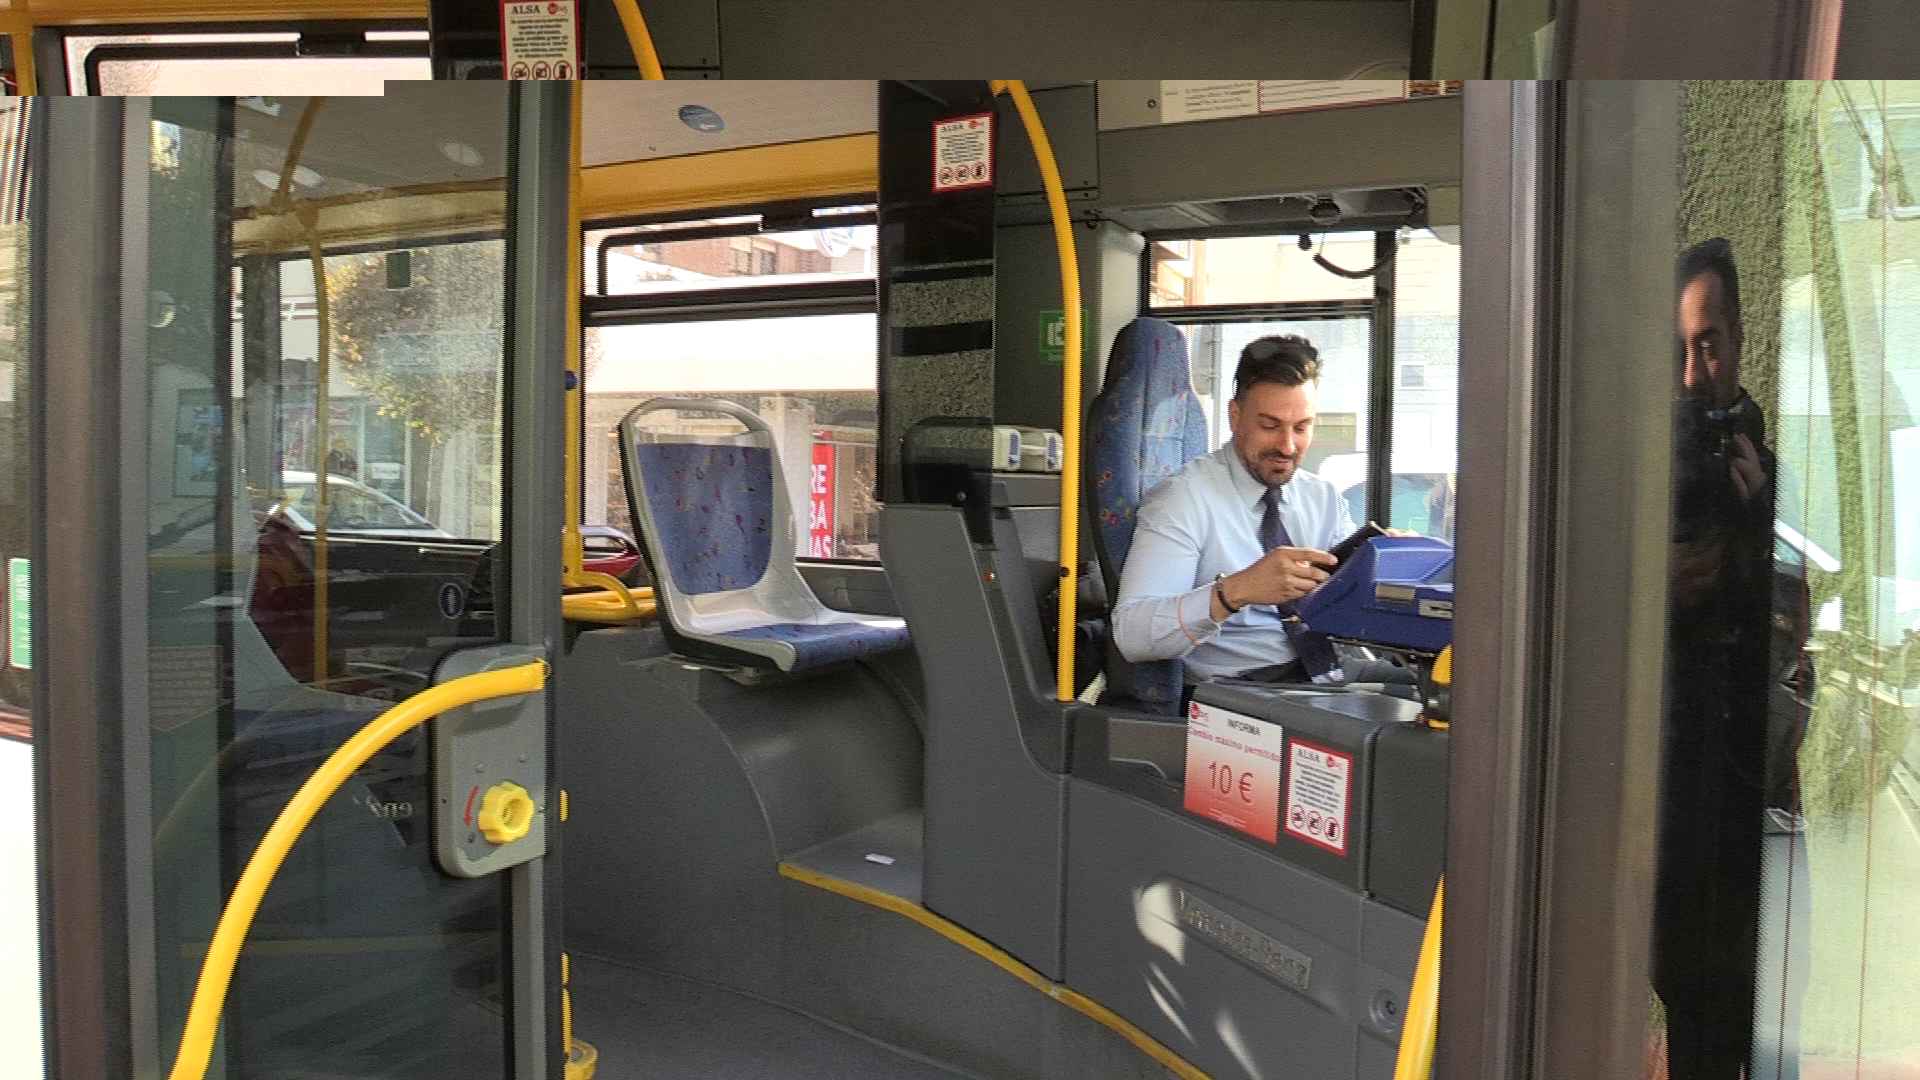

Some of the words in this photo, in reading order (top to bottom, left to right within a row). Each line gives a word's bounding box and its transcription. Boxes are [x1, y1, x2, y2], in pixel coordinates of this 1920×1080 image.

[511, 5, 540, 15] ALSA
[1228, 718, 1260, 736] INFORMA
[1208, 761, 1233, 794] 10
[1239, 772, 1254, 803] €
